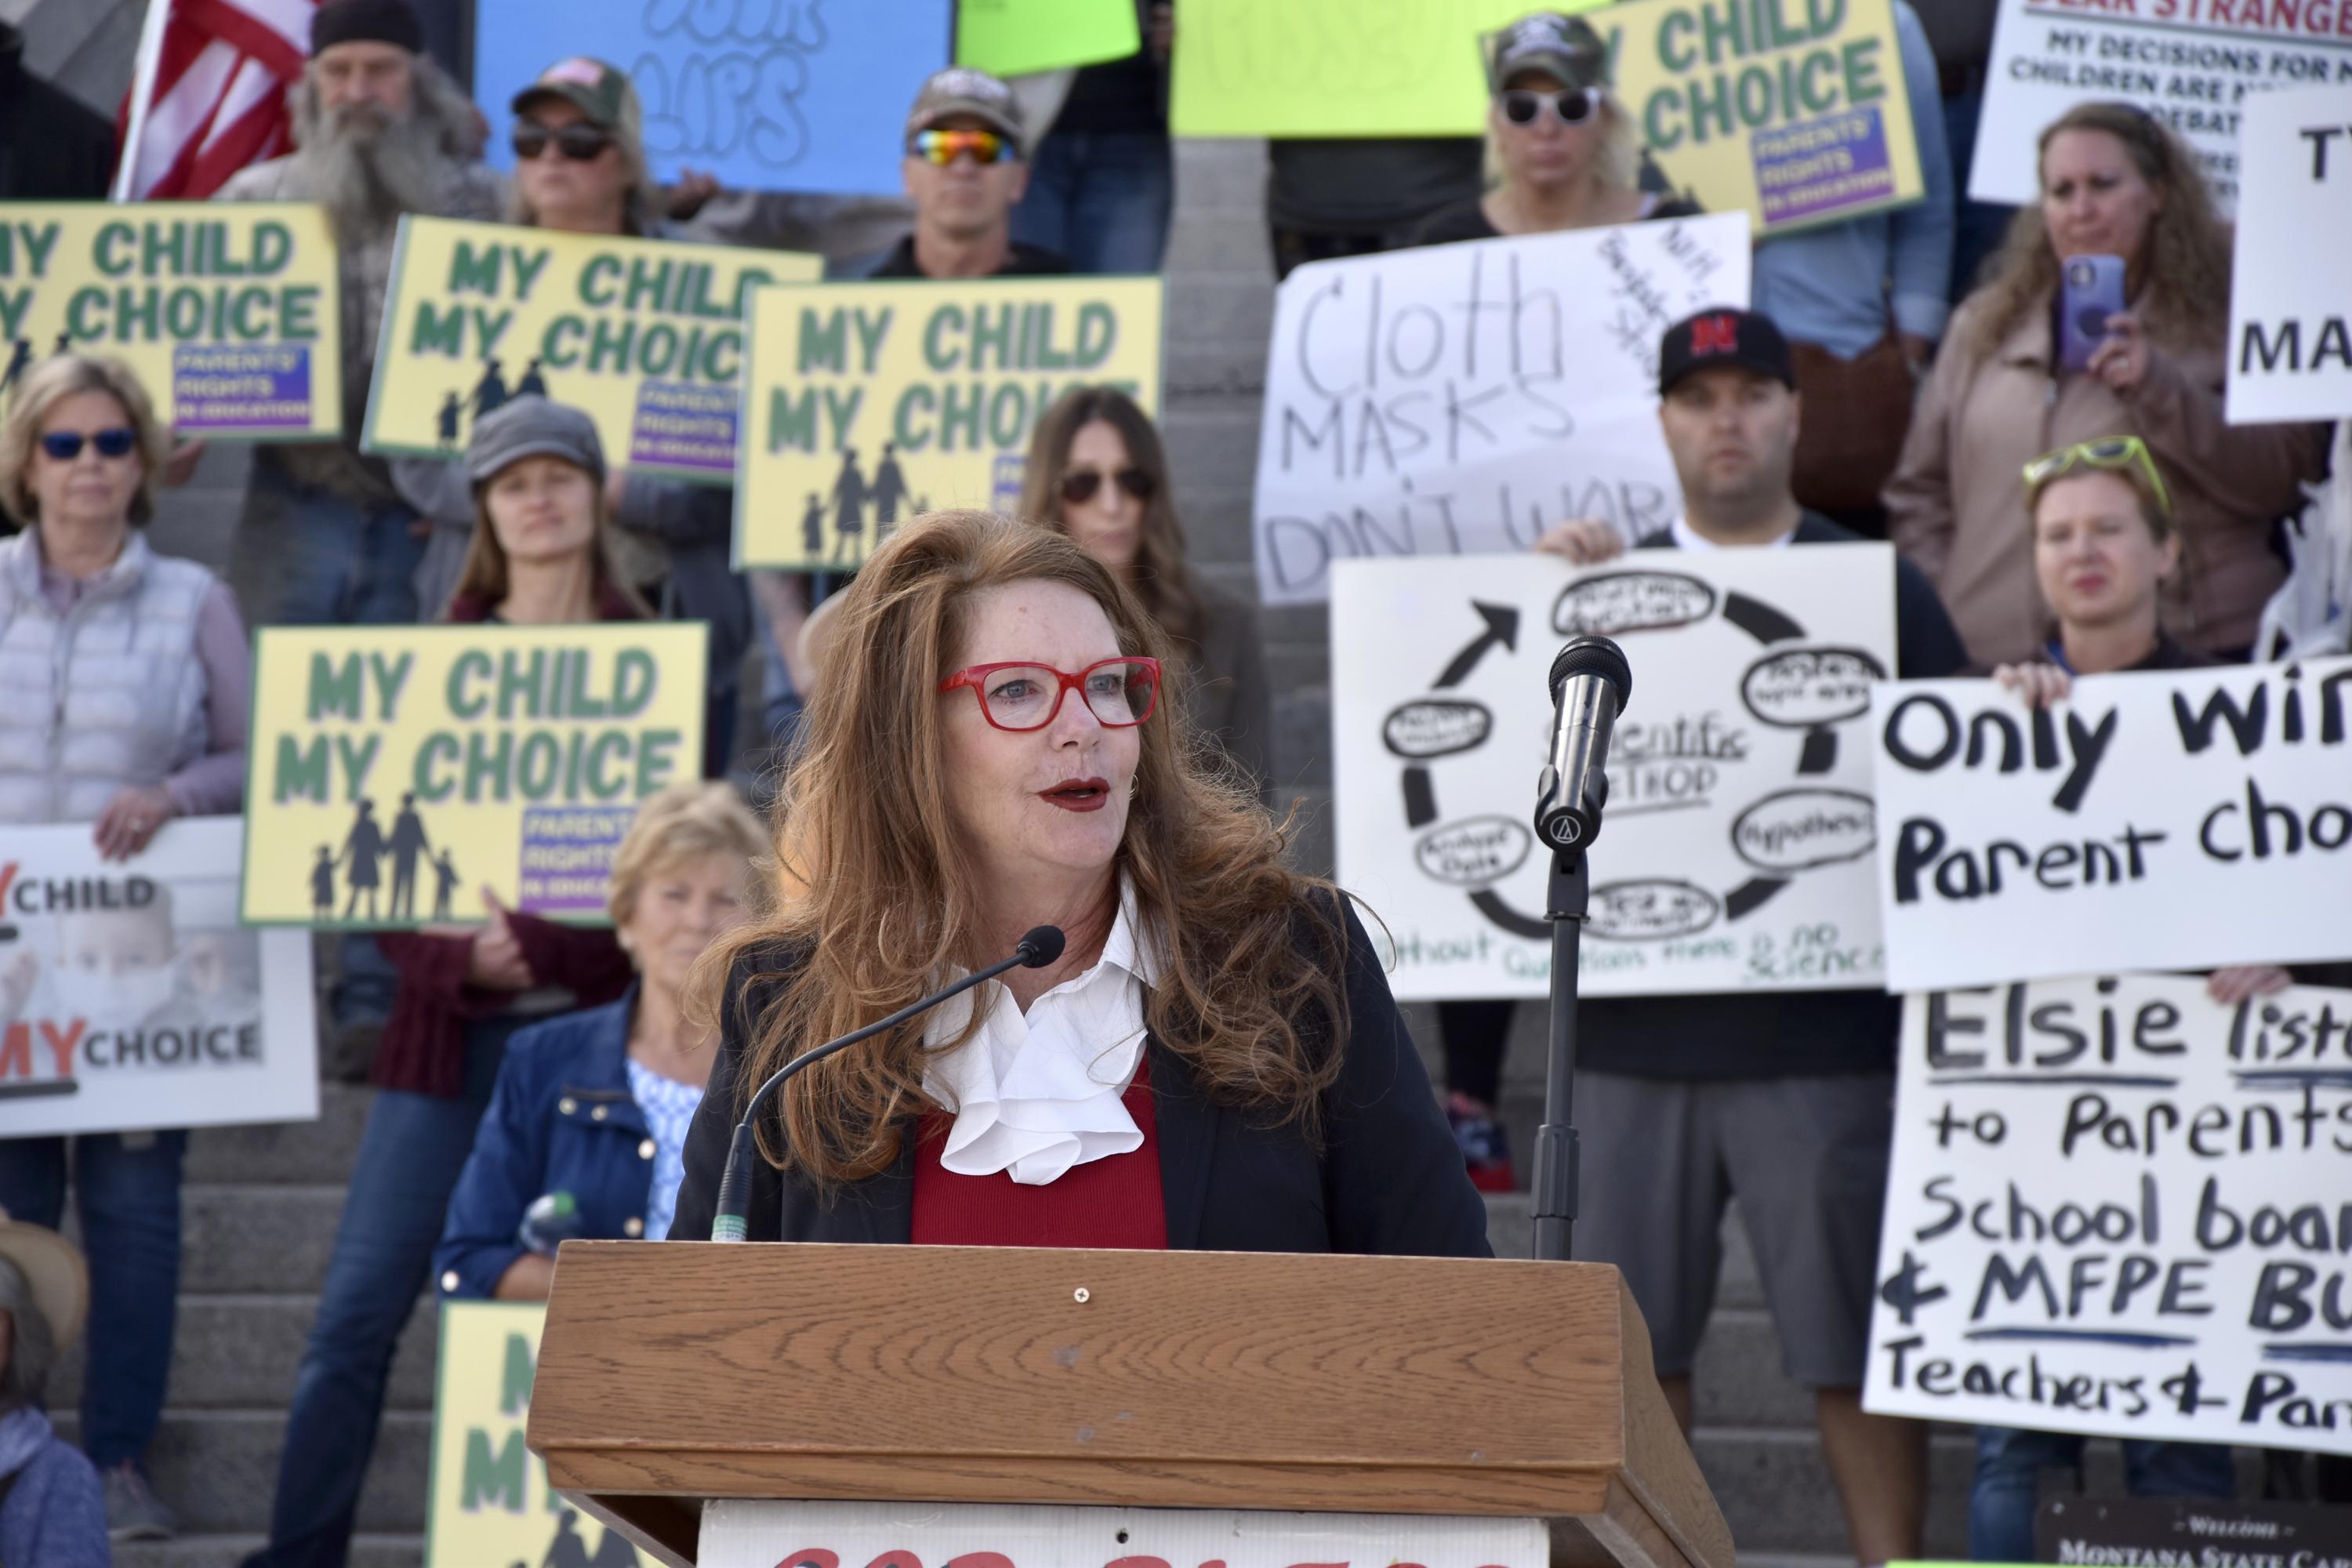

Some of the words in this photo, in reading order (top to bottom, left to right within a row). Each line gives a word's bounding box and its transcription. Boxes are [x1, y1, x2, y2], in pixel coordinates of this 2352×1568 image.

[1657, 0, 1846, 72] CHILD
[2048, 27, 2091, 53] MY
[2099, 34, 2261, 74] DECISIONS
[2272, 52, 2329, 82] FOR
[1643, 38, 1886, 149] CHOICE
[2008, 55, 2156, 96] CHILDREN
[2167, 74, 2223, 102] ARE
[2300, 125, 2352, 183] T
[0, 220, 60, 277] Y
[93, 220, 292, 278] CHILD
[447, 239, 549, 300] MY
[66, 284, 319, 342] CHOICE
[409, 300, 512, 359] MY
[541, 314, 742, 382] CHOIC
[797, 304, 894, 375] MY
[923, 302, 1118, 373] CHILD
[1690, 314, 1737, 354] N
[768, 387, 862, 453] MY
[1283, 376, 1574, 480] MASKS
[306, 649, 414, 723] MY
[445, 646, 657, 720] CHILD
[273, 731, 381, 804] MY
[412, 729, 681, 804] CHOICE
[1883, 692, 2118, 813] Only
[1894, 815, 2167, 904] Parent
[2199, 775, 2352, 862] cho
[14, 875, 156, 915] CHILD
[84, 1024, 263, 1069] CHOICE
[1926, 978, 2187, 1069] Elsie
[2228, 994, 2352, 1060] list
[1929, 1101, 2007, 1149] to
[1915, 1172, 2159, 1245] School
[1969, 1252, 2216, 1323] MFPE
[1882, 1335, 2150, 1418] Teachers
[2059, 1538, 2194, 1567] MONTANA
[2201, 1546, 2284, 1568] STATE
[2189, 1516, 2281, 1539] WELCOME
